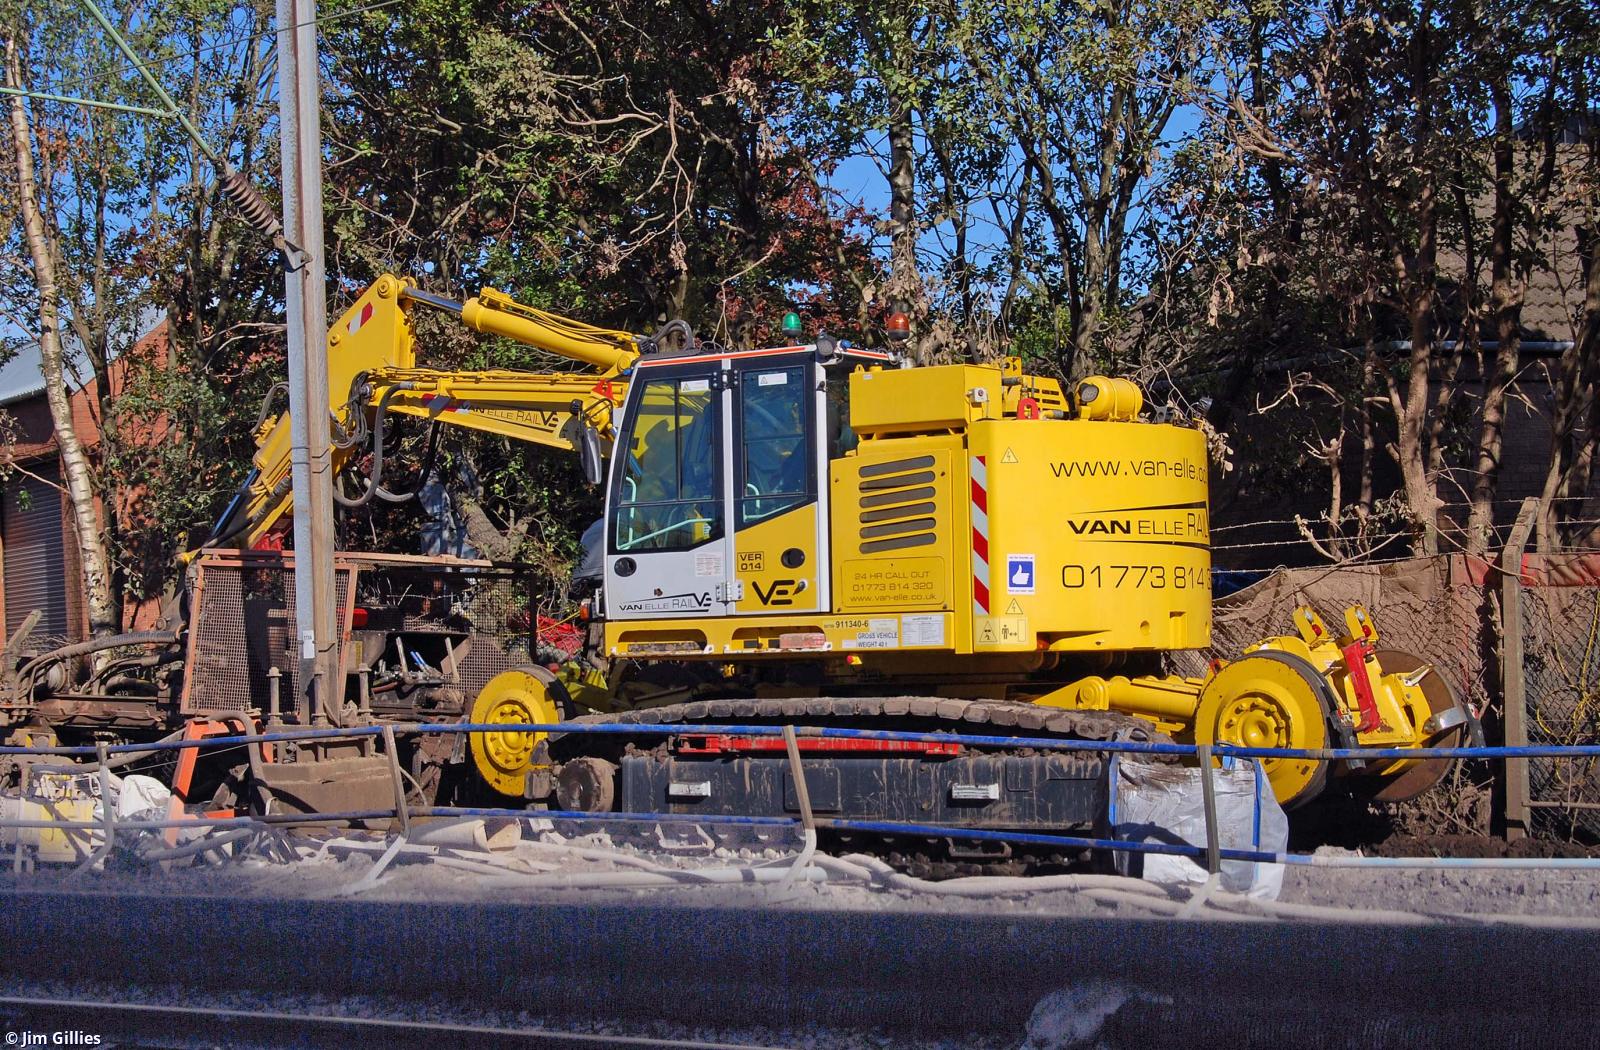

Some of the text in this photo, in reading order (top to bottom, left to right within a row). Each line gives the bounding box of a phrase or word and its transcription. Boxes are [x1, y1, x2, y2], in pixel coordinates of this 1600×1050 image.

[487, 409, 513, 420] ELLE
[515, 409, 540, 426] RAIL
[1067, 519, 1131, 535] VAN
[1138, 519, 1184, 536] ELLE
[739, 553, 762, 562] VER
[740, 562, 762, 571] 014
[854, 572, 867, 580] 24
[885, 571, 909, 579] CALL
[1061, 565, 1166, 589] 01773
[852, 583, 887, 592] 01773
[912, 582, 934, 590] 320
[849, 593, 937, 602] www.van-elle.co.uk
[618, 603, 643, 611] VAN
[644, 602, 670, 610] ELLE
[672, 598, 696, 609] RAIL
[835, 620, 869, 629] 911340-6
[857, 631, 899, 640] GROSS VEHICLE
